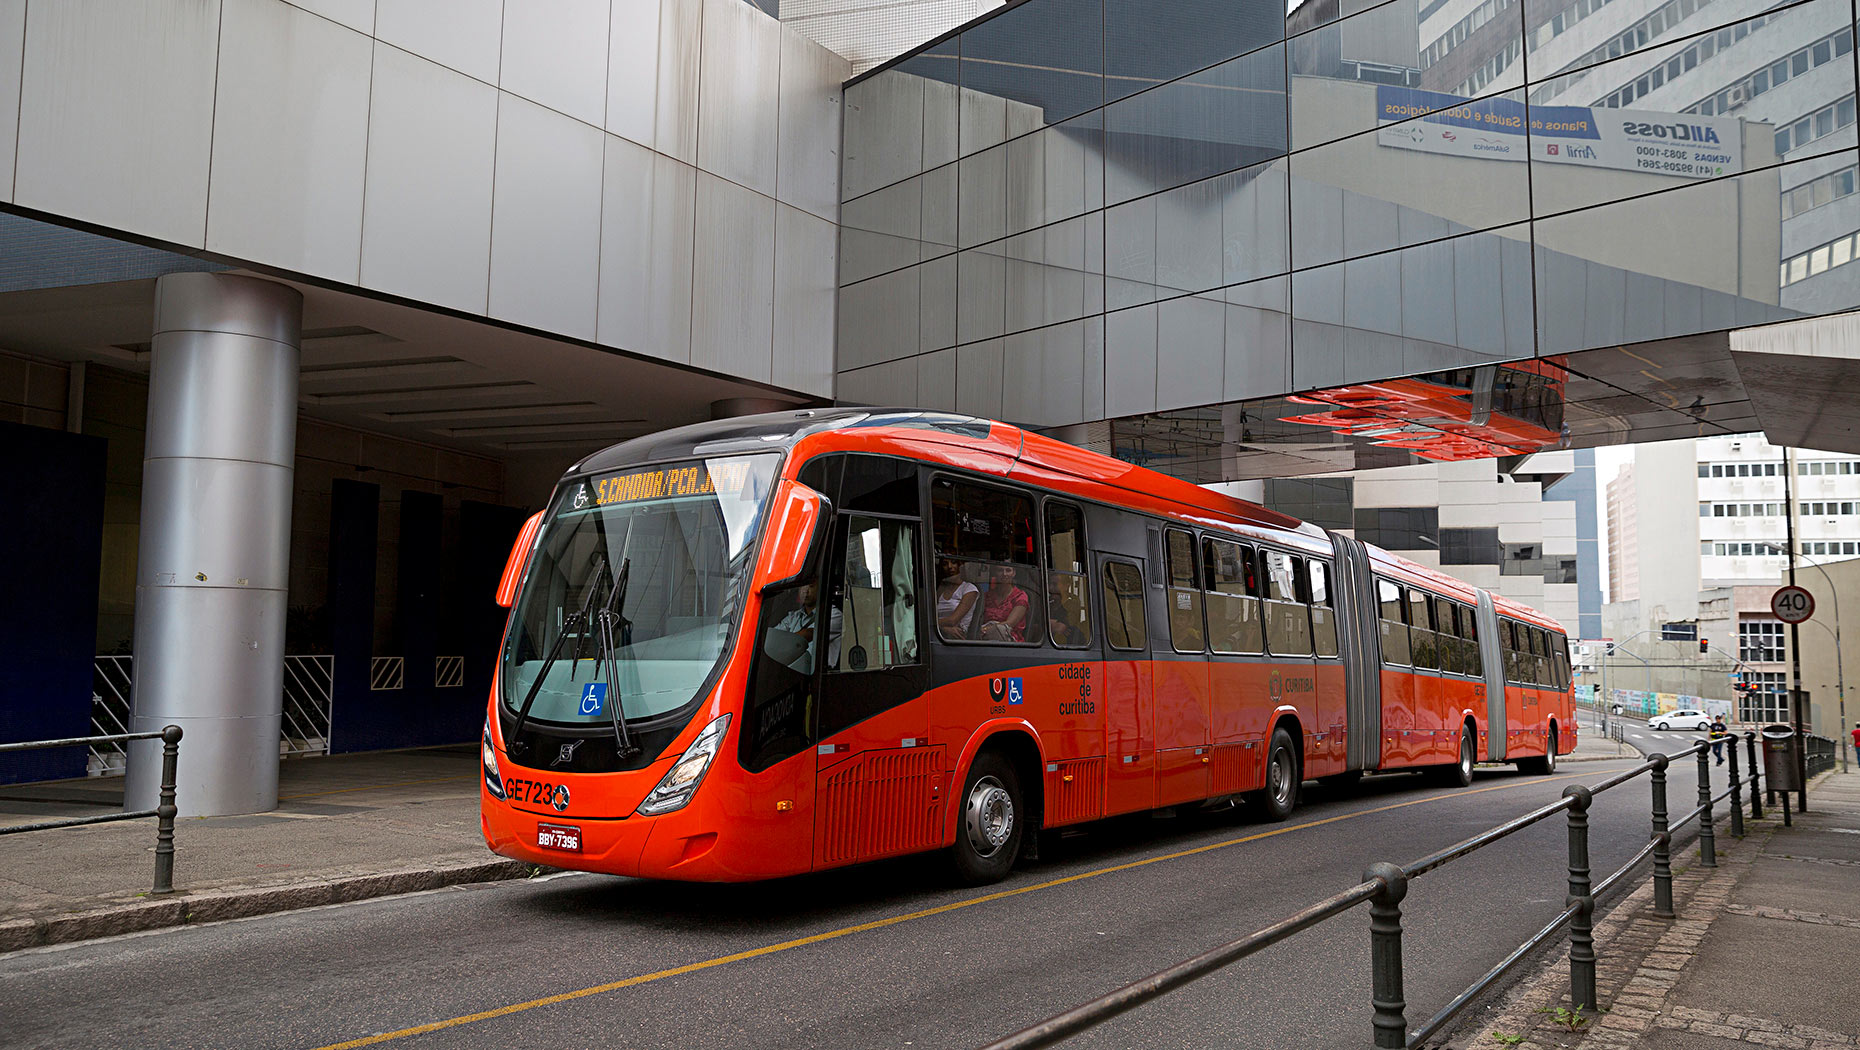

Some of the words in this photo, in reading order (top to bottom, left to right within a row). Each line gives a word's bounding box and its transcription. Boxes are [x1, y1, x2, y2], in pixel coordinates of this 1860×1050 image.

[1778, 593, 1806, 611] 40
[1059, 664, 1091, 680] cidade
[1079, 679, 1092, 697] de
[1285, 677, 1315, 693] CURITIBA
[990, 705, 1006, 715] URBS
[1059, 697, 1095, 715] curitiba
[505, 778, 553, 805] GE723
